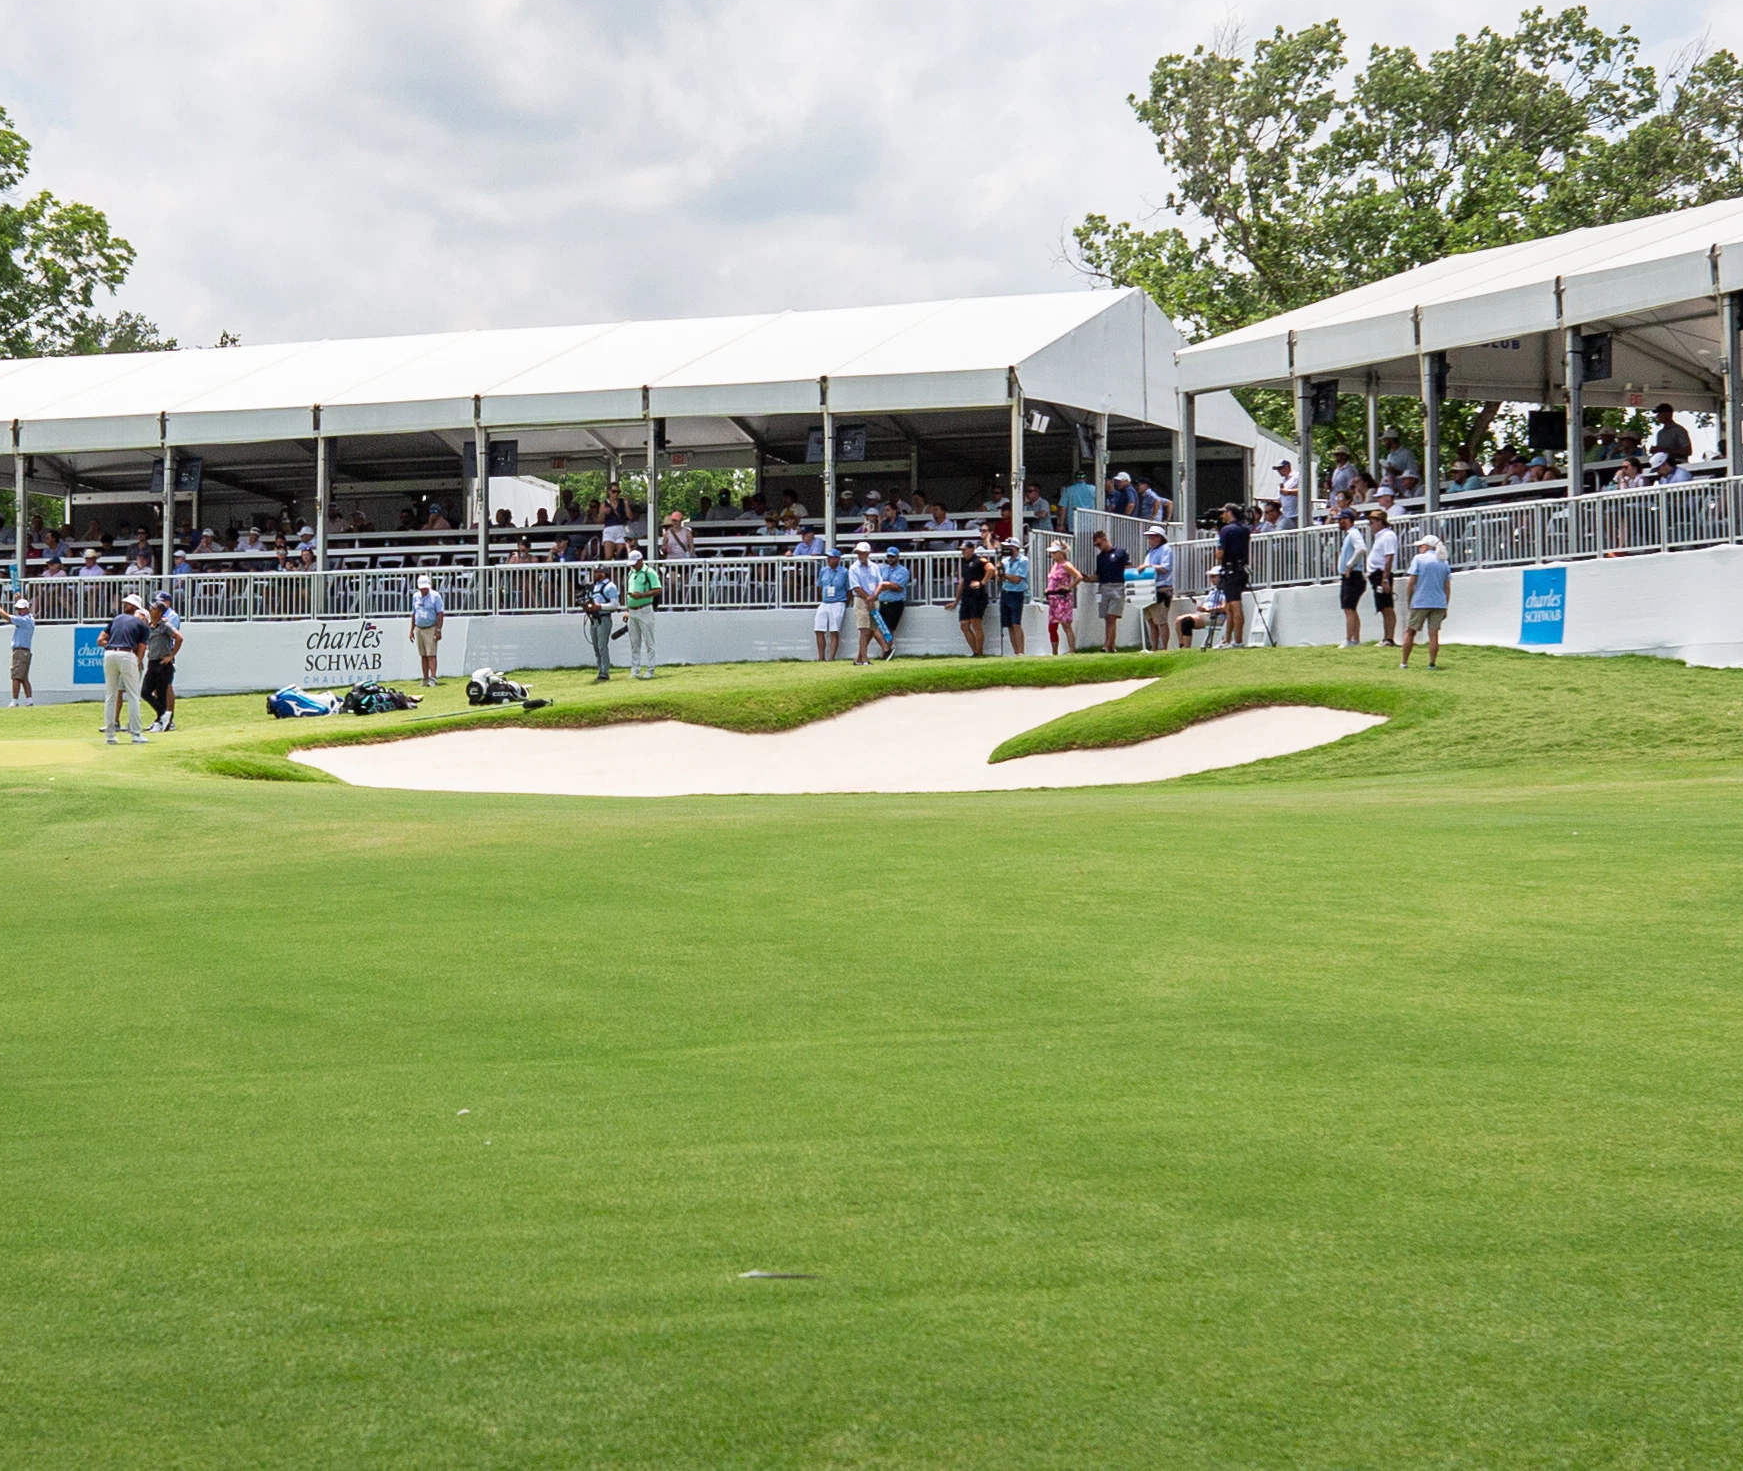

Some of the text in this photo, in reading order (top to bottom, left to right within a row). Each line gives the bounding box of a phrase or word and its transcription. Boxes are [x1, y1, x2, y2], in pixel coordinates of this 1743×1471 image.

[1525, 588, 1562, 609] charles
[1523, 609, 1562, 623] SCHWAB
[306, 621, 383, 650] charles
[77, 642, 105, 656] char
[77, 657, 104, 667] SCHW
[304, 653, 382, 672] SCHWAB
[303, 674, 382, 684] CHALLENGE
